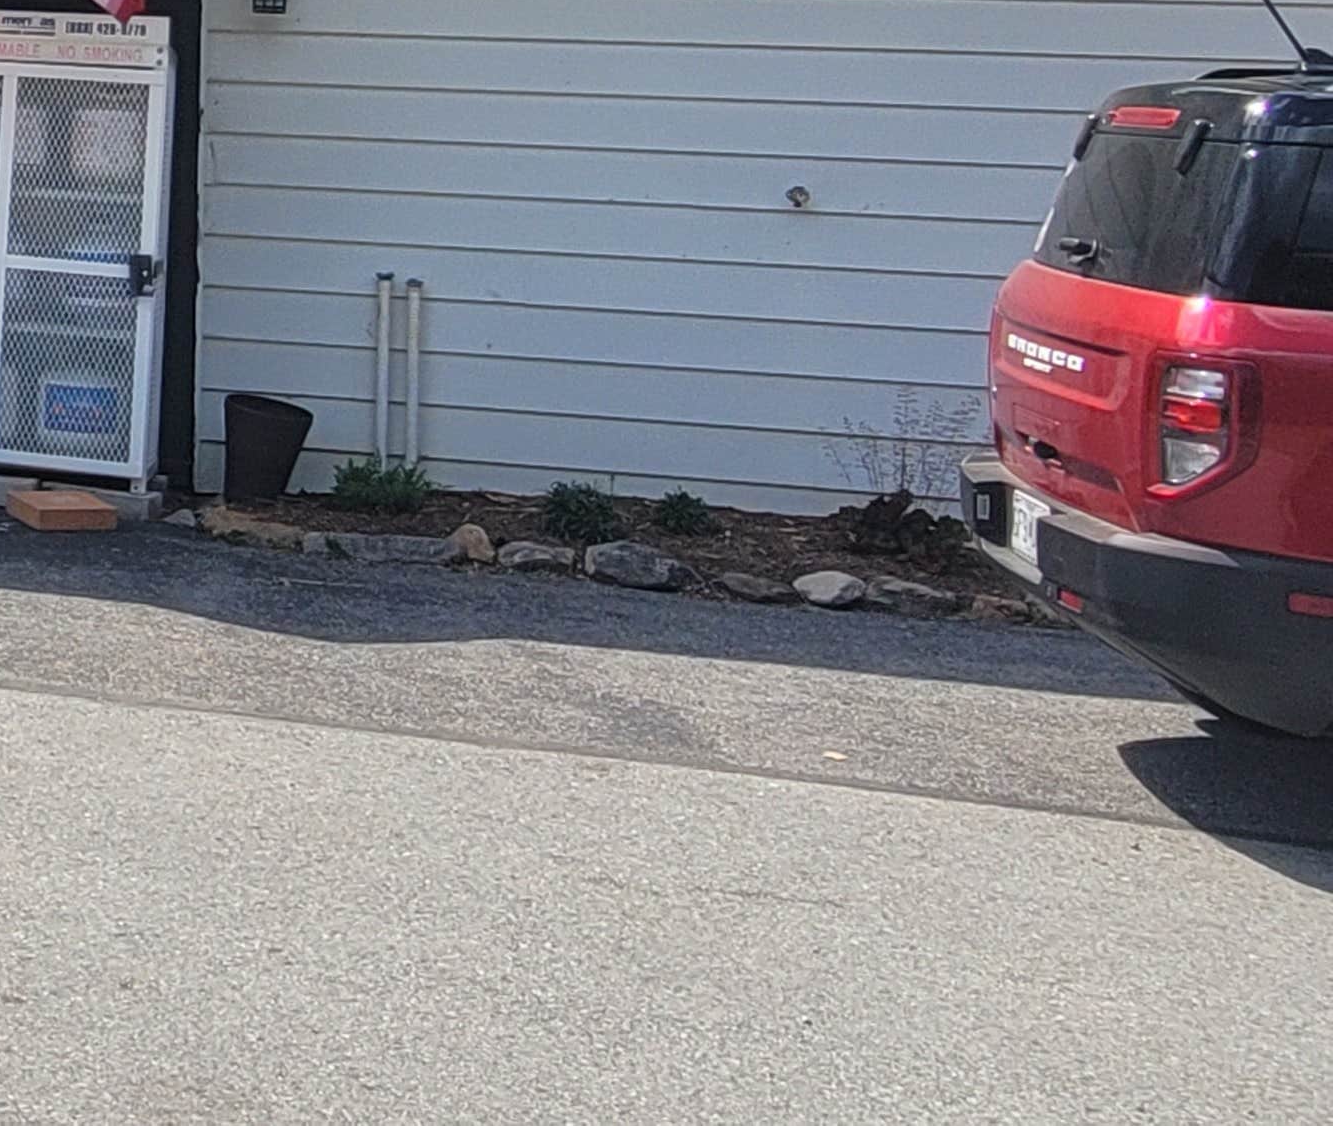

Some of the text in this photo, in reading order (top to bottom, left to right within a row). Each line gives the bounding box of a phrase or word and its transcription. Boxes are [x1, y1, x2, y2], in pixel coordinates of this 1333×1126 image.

[56, 45, 77, 58] NO
[84, 46, 144, 62] SMOKING
[1007, 333, 1085, 372] BRONCO
